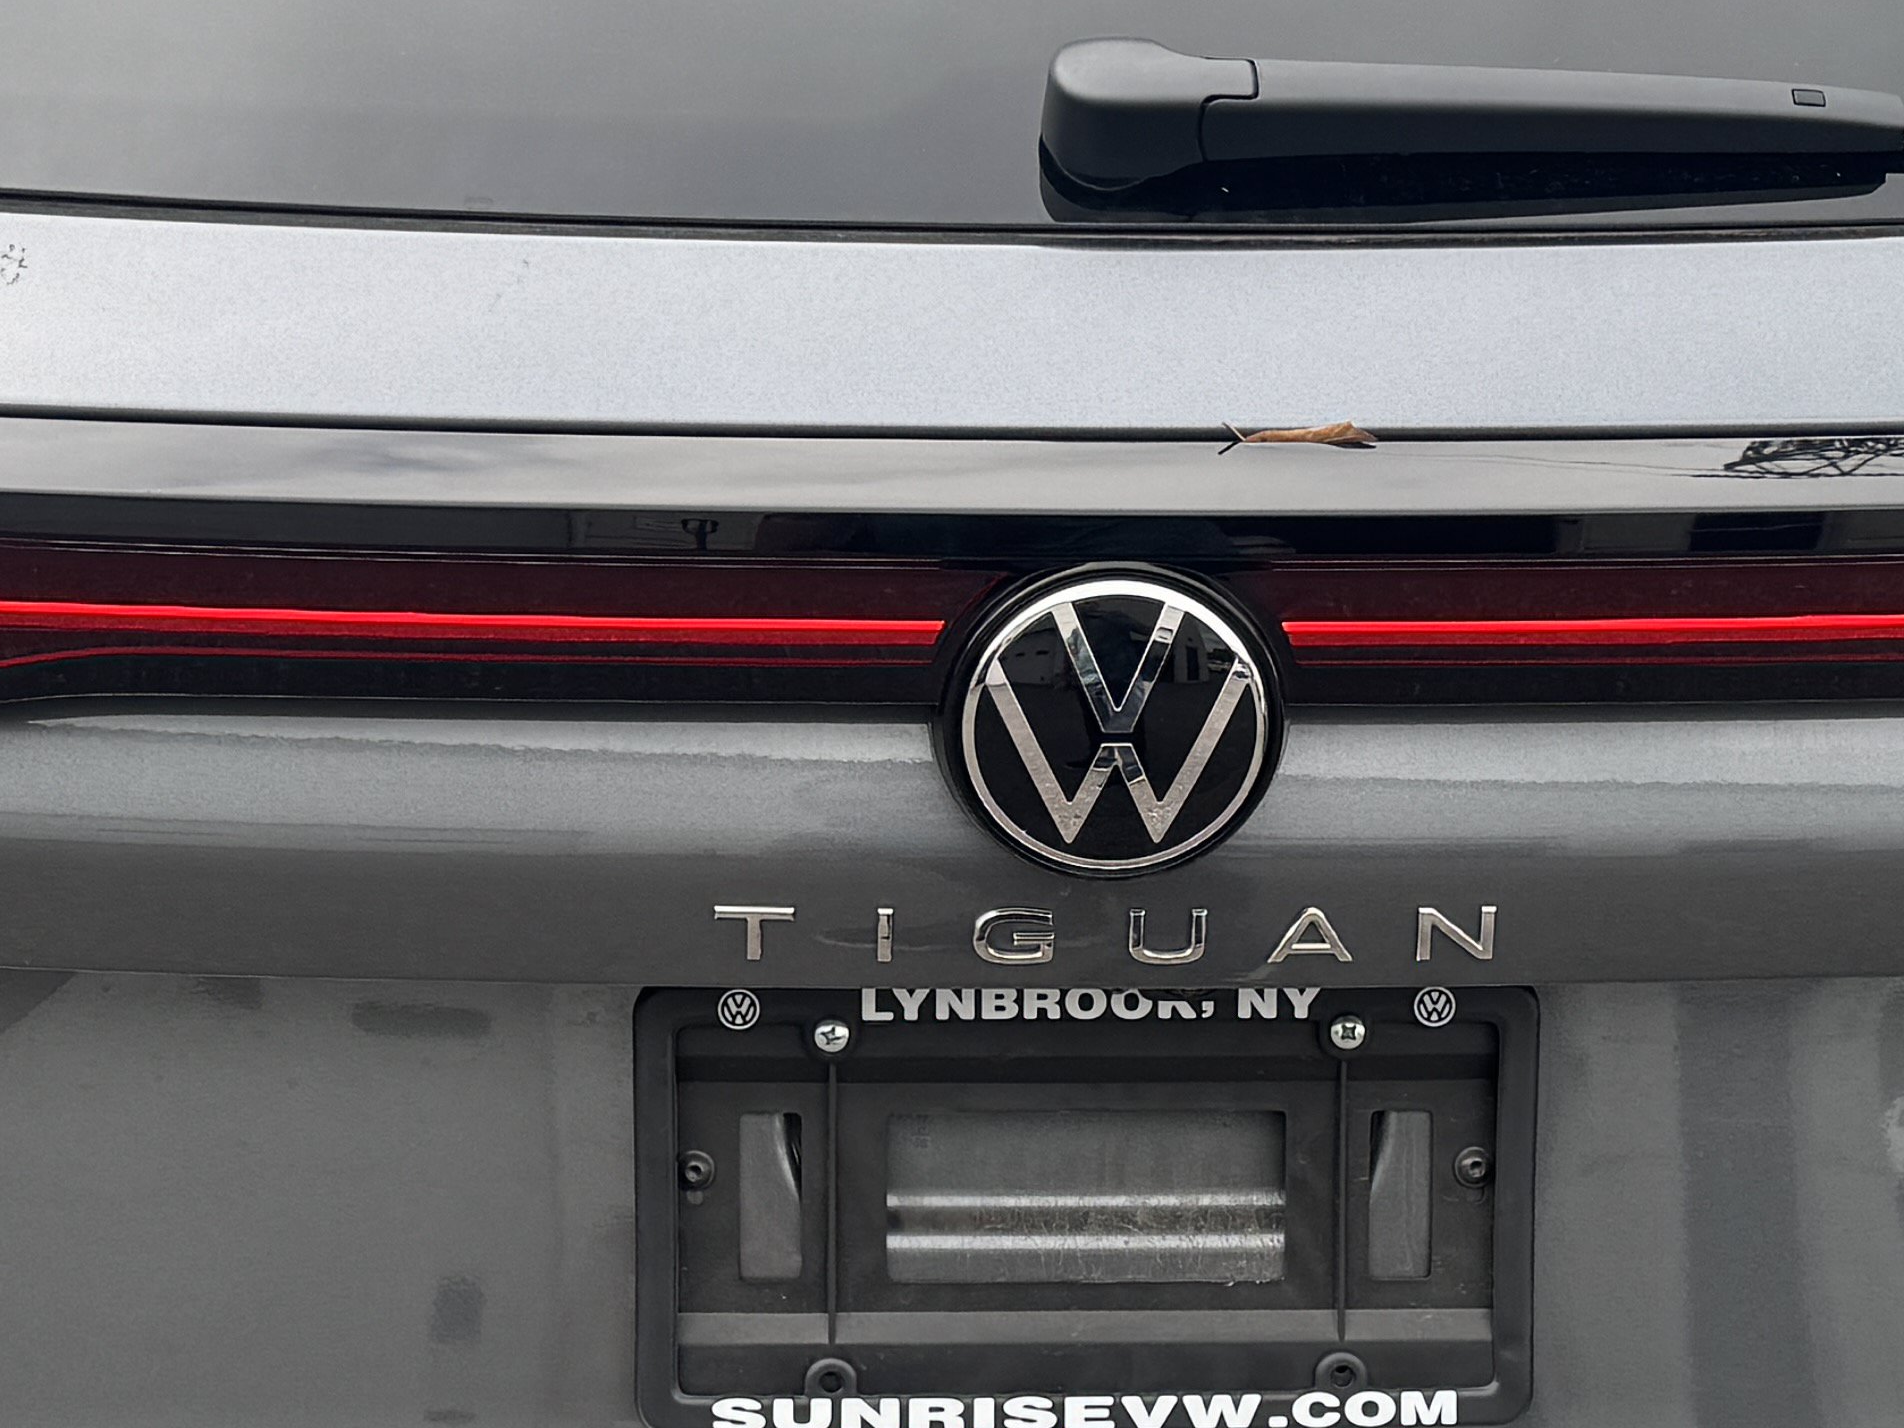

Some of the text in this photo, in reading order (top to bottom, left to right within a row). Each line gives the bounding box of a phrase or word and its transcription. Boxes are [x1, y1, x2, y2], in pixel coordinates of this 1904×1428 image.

[970, 587, 1258, 860] VW
[713, 905, 1498, 964] TIGUAN
[1237, 988, 1321, 1019] NY
